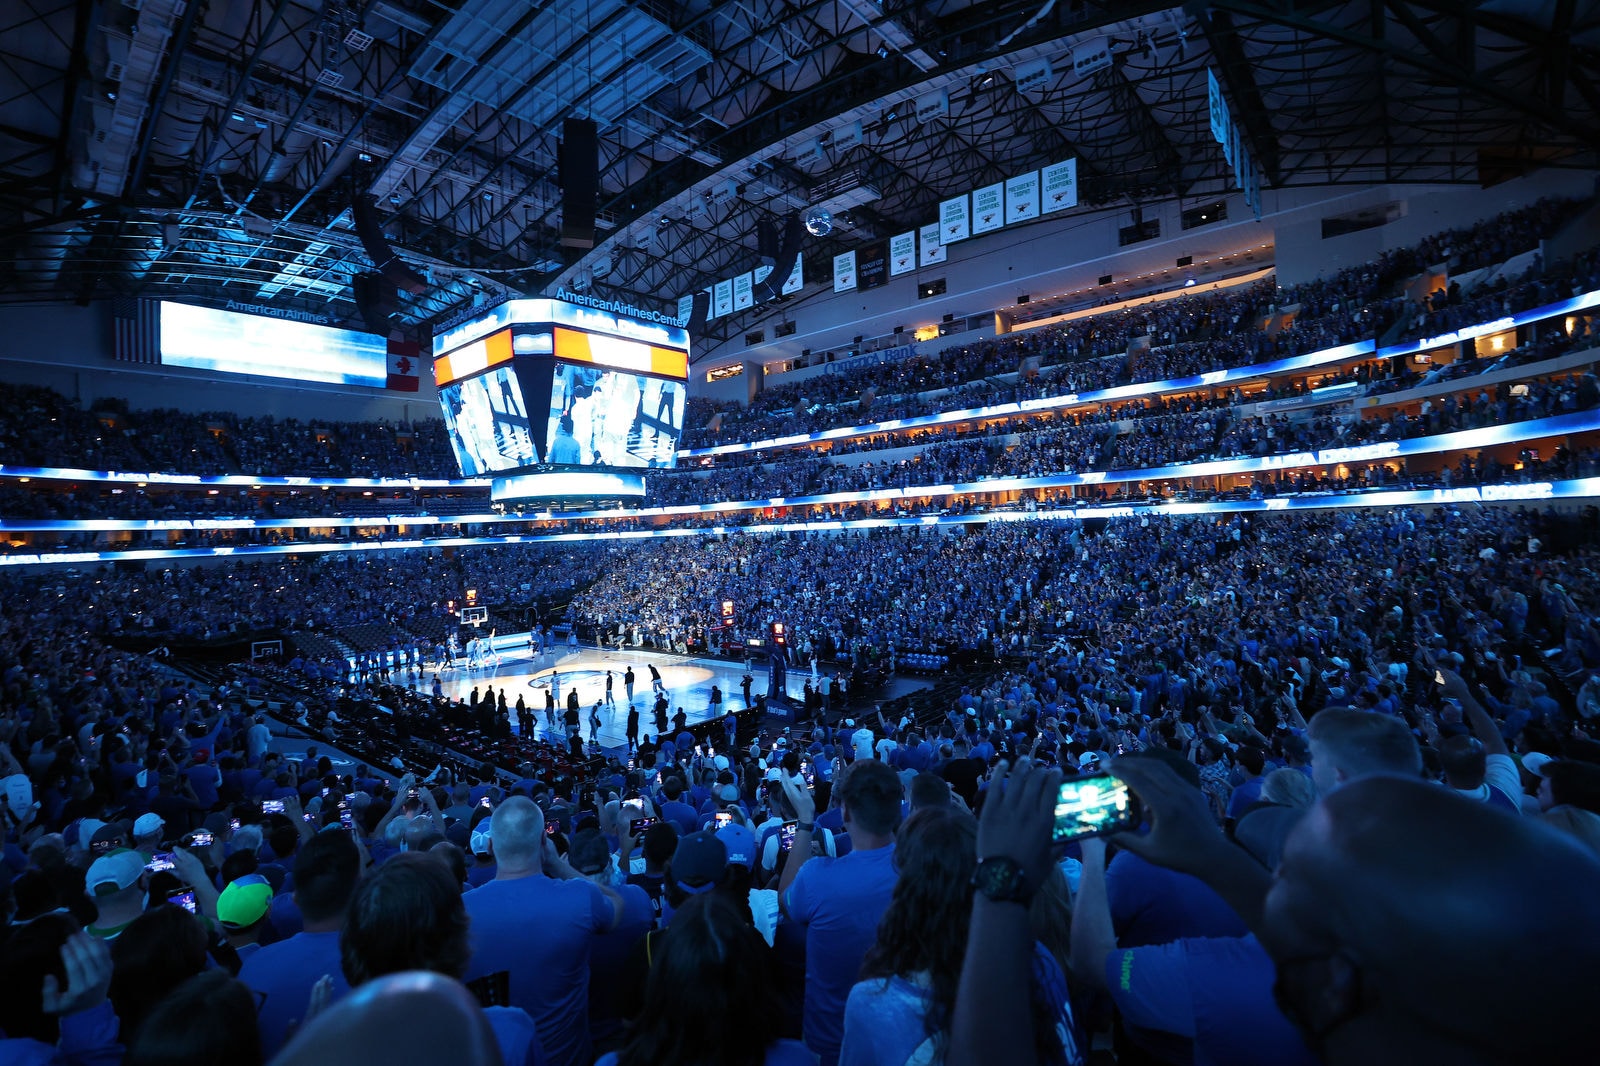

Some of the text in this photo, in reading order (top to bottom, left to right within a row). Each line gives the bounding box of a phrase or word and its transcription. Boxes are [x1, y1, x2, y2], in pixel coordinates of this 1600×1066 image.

[884, 344, 918, 362] Bank
[1262, 453, 1318, 469] LUKA
[1434, 487, 1481, 502] LUKA
[1120, 950, 1135, 991] chime
